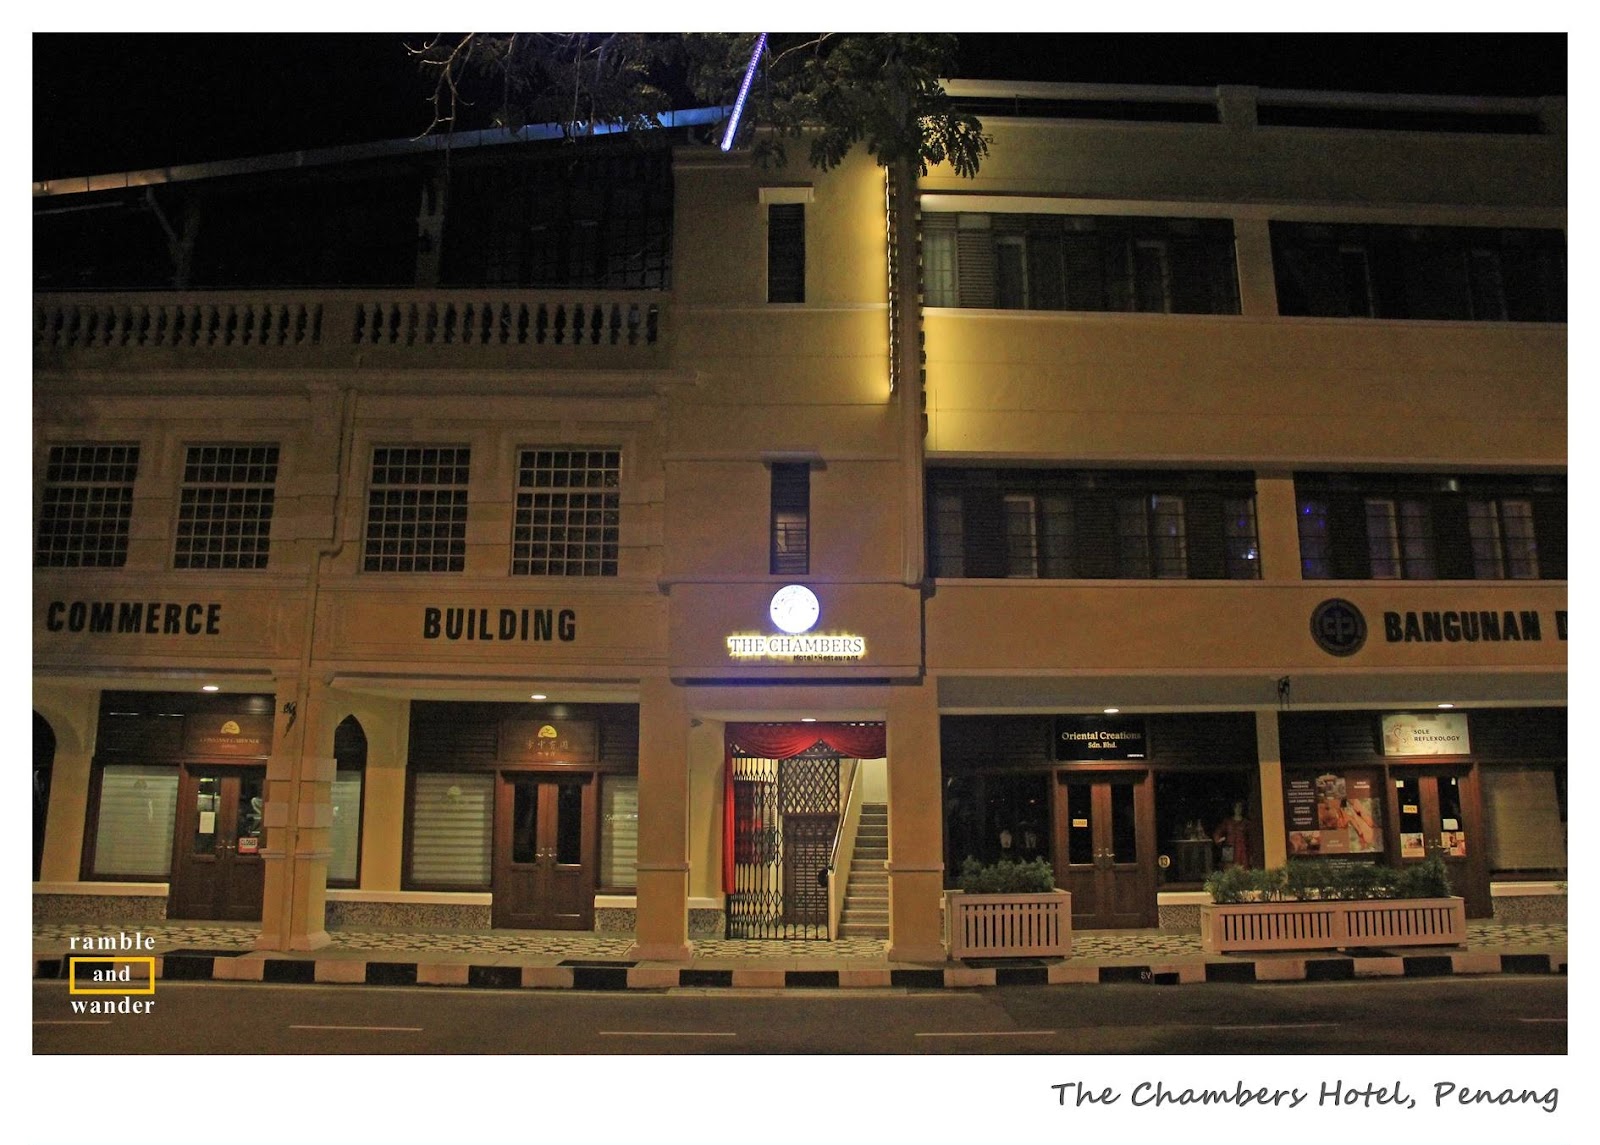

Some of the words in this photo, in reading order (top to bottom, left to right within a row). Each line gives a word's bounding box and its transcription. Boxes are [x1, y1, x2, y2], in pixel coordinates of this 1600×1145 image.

[47, 601, 222, 635] COMMERCE
[423, 607, 576, 642] BUILDING
[1383, 611, 1542, 642] BANGUNAN
[730, 639, 764, 653] THE
[769, 639, 862, 653] CHAMBERS
[1061, 731, 1099, 740] Oriental
[1100, 731, 1142, 740] Creations
[1088, 741, 1102, 749] Sdn.
[1103, 741, 1118, 749] Bhd.
